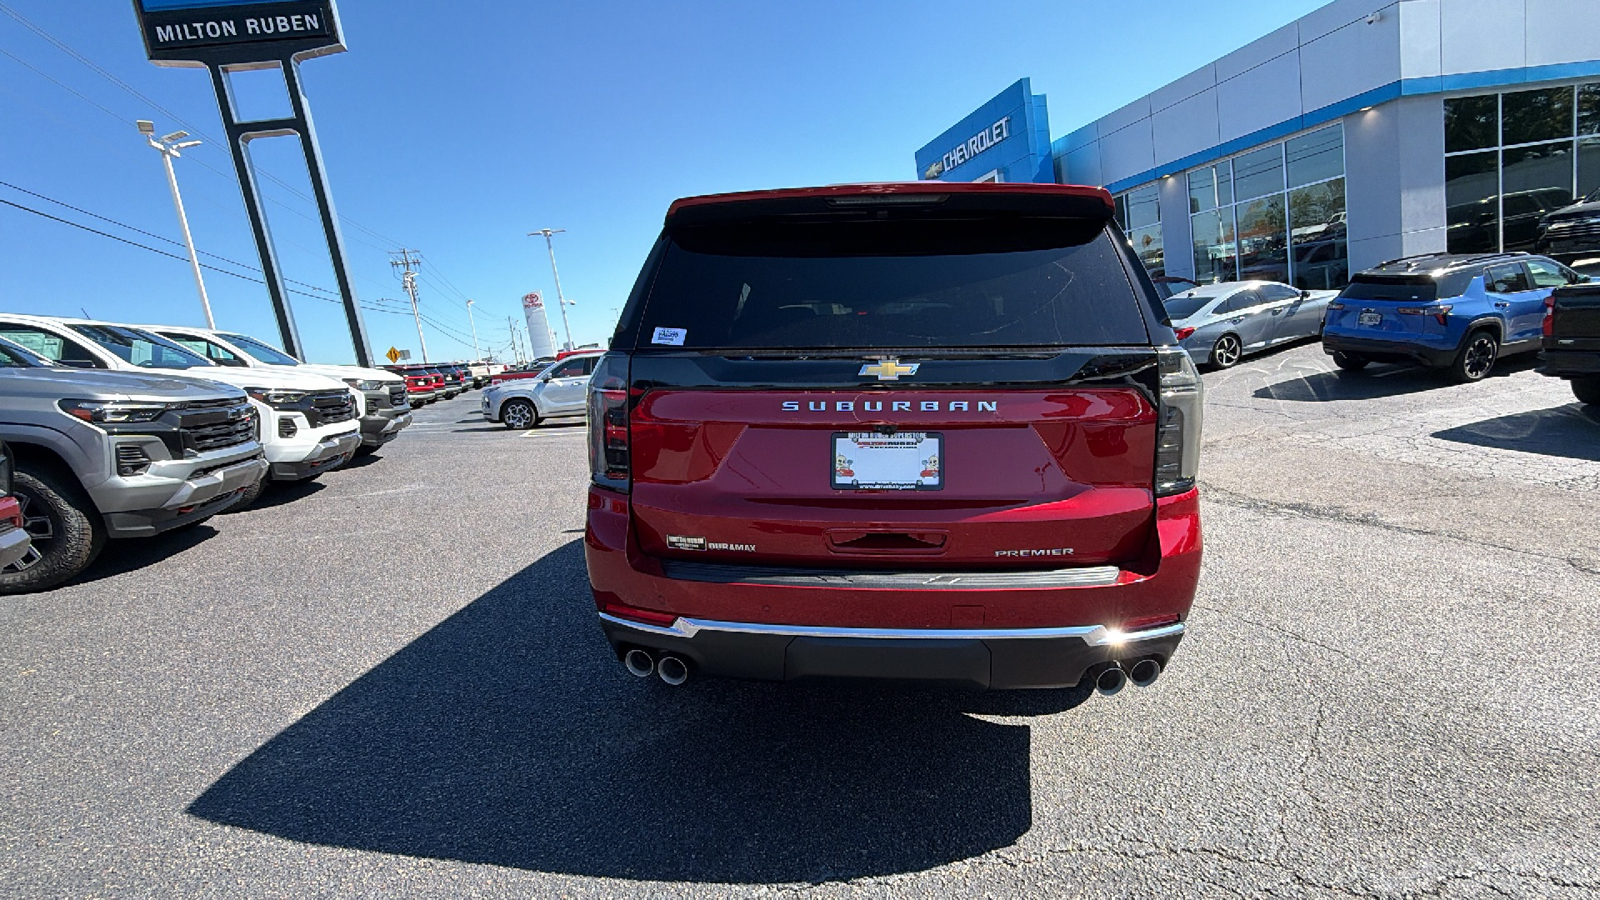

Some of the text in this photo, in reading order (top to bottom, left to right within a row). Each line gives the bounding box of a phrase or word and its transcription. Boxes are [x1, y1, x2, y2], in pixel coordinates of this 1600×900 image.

[155, 14, 319, 42] MILTON RUBEN
[942, 116, 1008, 172] CHEVROLET
[781, 401, 997, 412] SUBURBAN
[708, 542, 757, 552] DURAMAX
[994, 548, 1074, 557] PREMIER
